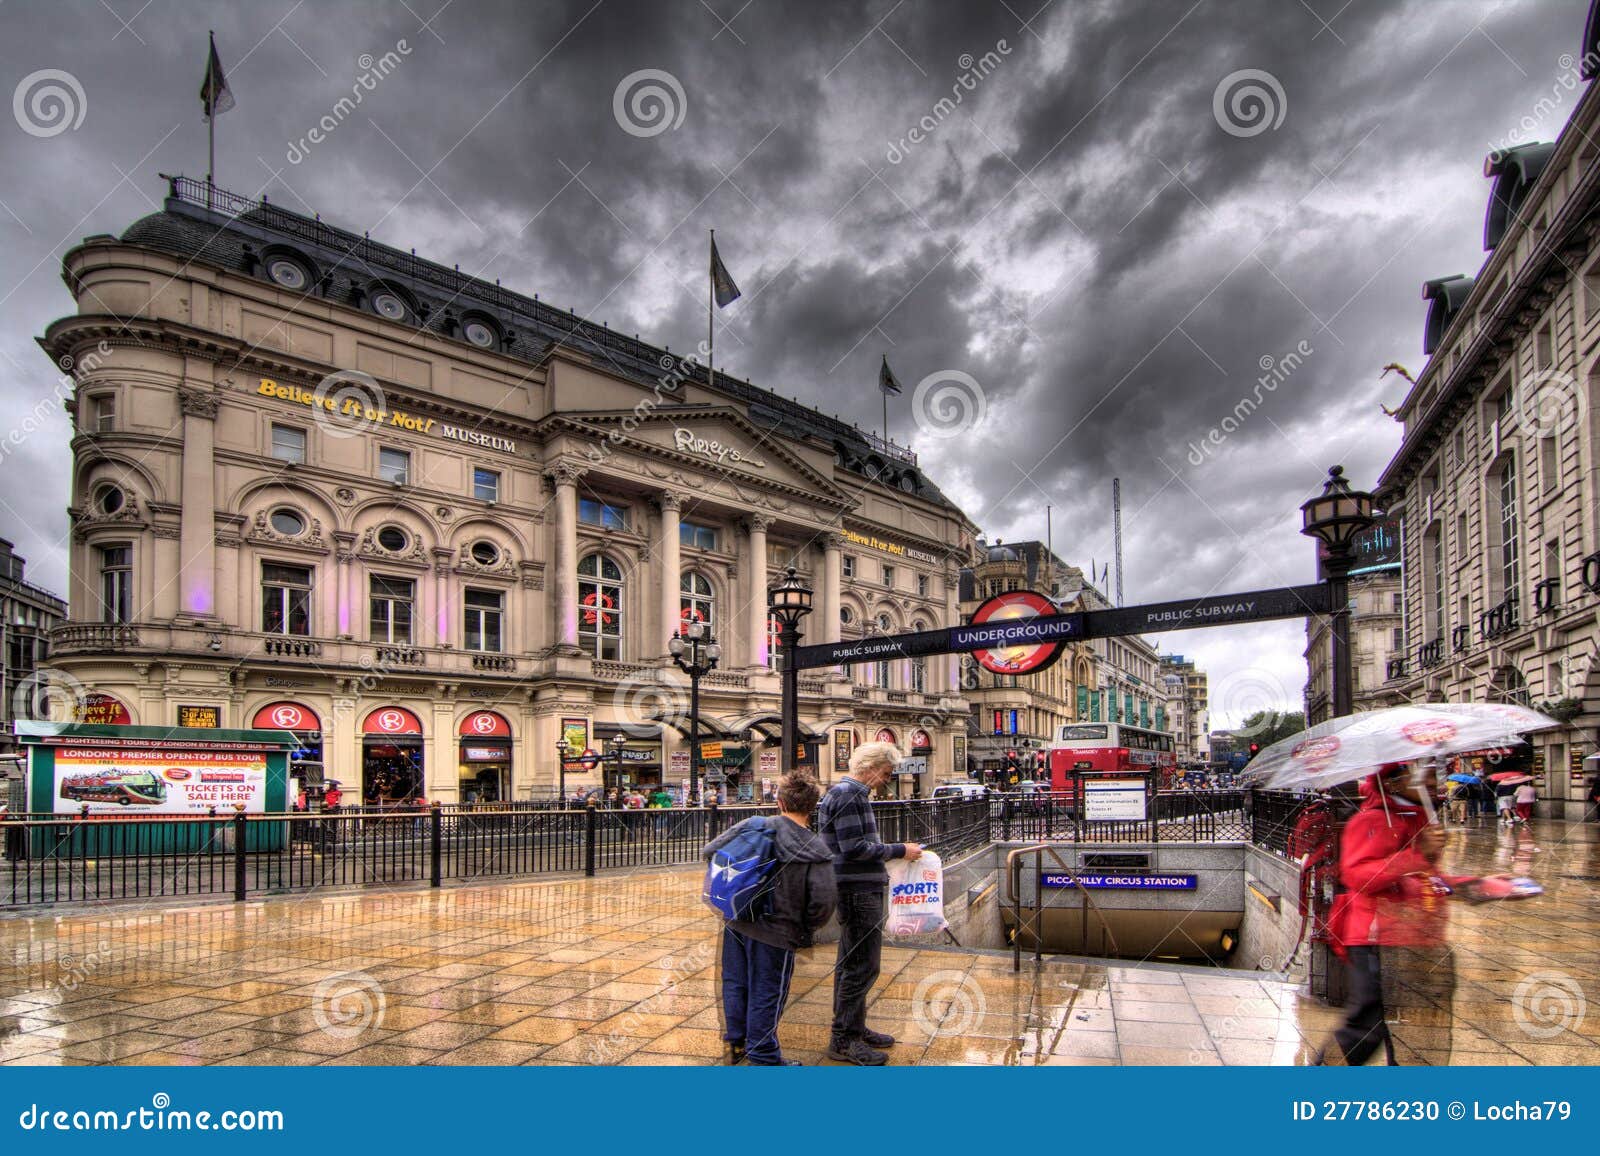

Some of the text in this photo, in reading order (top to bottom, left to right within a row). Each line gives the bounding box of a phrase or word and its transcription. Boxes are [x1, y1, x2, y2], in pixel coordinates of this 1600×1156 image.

[256, 378, 516, 453] Believe It or Not! MUSEUM
[674, 428, 742, 462] Ripley's
[1148, 601, 1255, 623] PUBLIC SUBWAY
[958, 621, 1071, 644] UNDERGROUND
[832, 642, 902, 657] PUBLIC SUBWAY
[109, 703, 122, 714] It
[65, 737, 120, 745] SIGHTSEEING
[123, 738, 149, 746] TOURS
[150, 739, 162, 747] OF
[164, 740, 197, 748] LONDON
[63, 749, 119, 759] LONDON'S
[121, 751, 163, 759] PREMIER
[215, 753, 234, 761] BUS
[236, 753, 261, 761] TOUR
[184, 784, 233, 792] TICKETS
[187, 793, 251, 801] SALE HERE
[1105, 877, 1142, 885] CIRCUS
[1144, 877, 1187, 886] STATION
